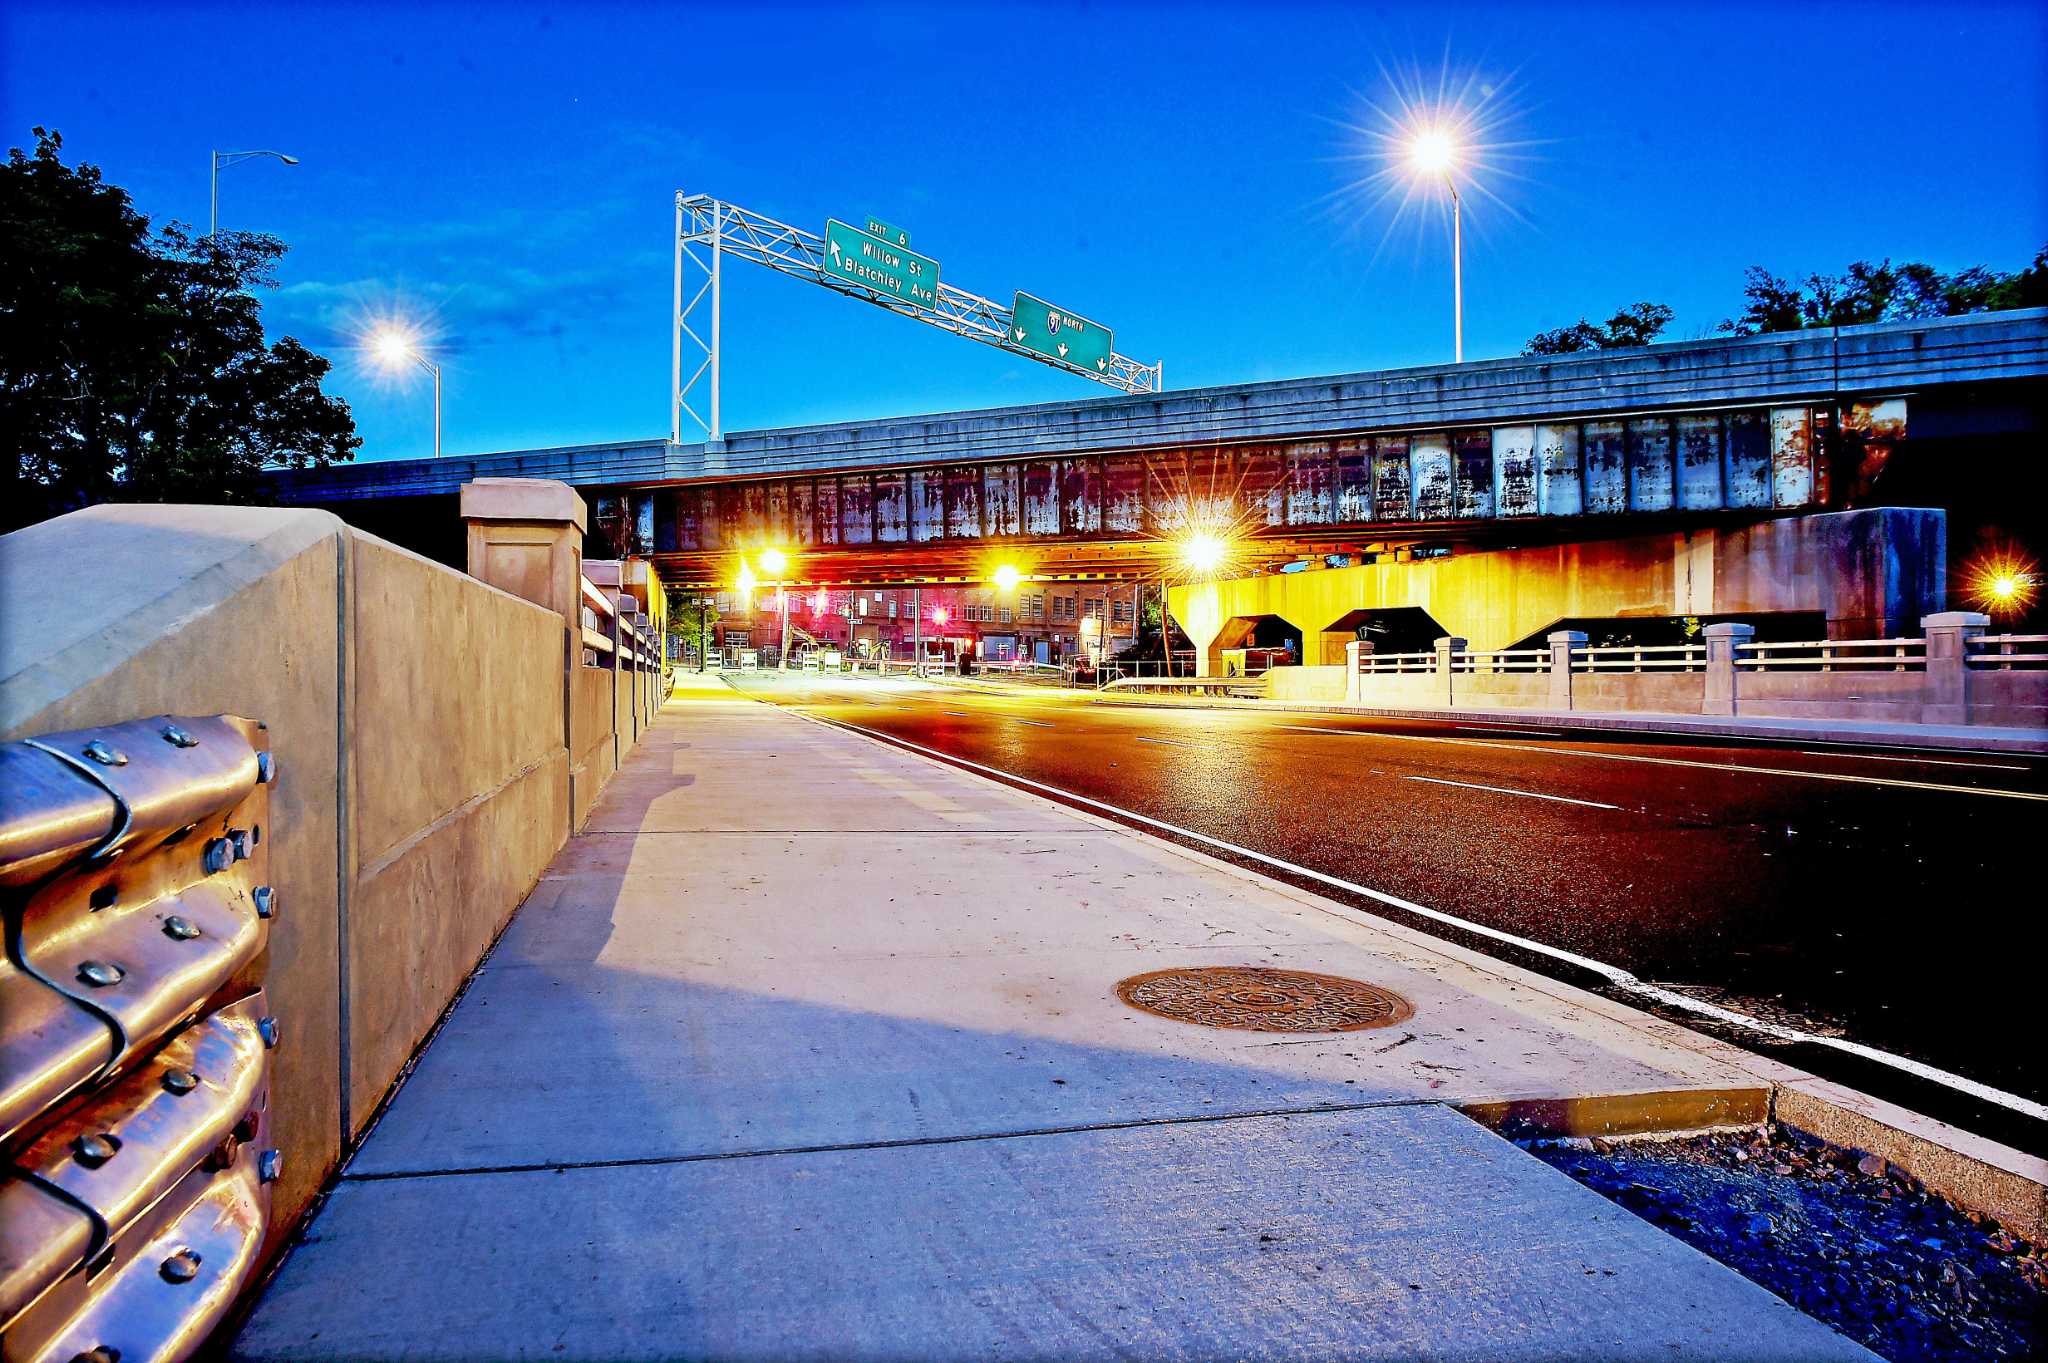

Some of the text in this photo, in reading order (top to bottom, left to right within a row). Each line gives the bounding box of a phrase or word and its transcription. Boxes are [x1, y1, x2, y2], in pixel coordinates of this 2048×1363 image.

[869, 221, 906, 245] EXIT 6
[863, 241, 922, 277] Willow St
[845, 257, 932, 301] Blatchley Ave
[1050, 316, 1059, 330] 91
[1063, 316, 1085, 332] NORTH
